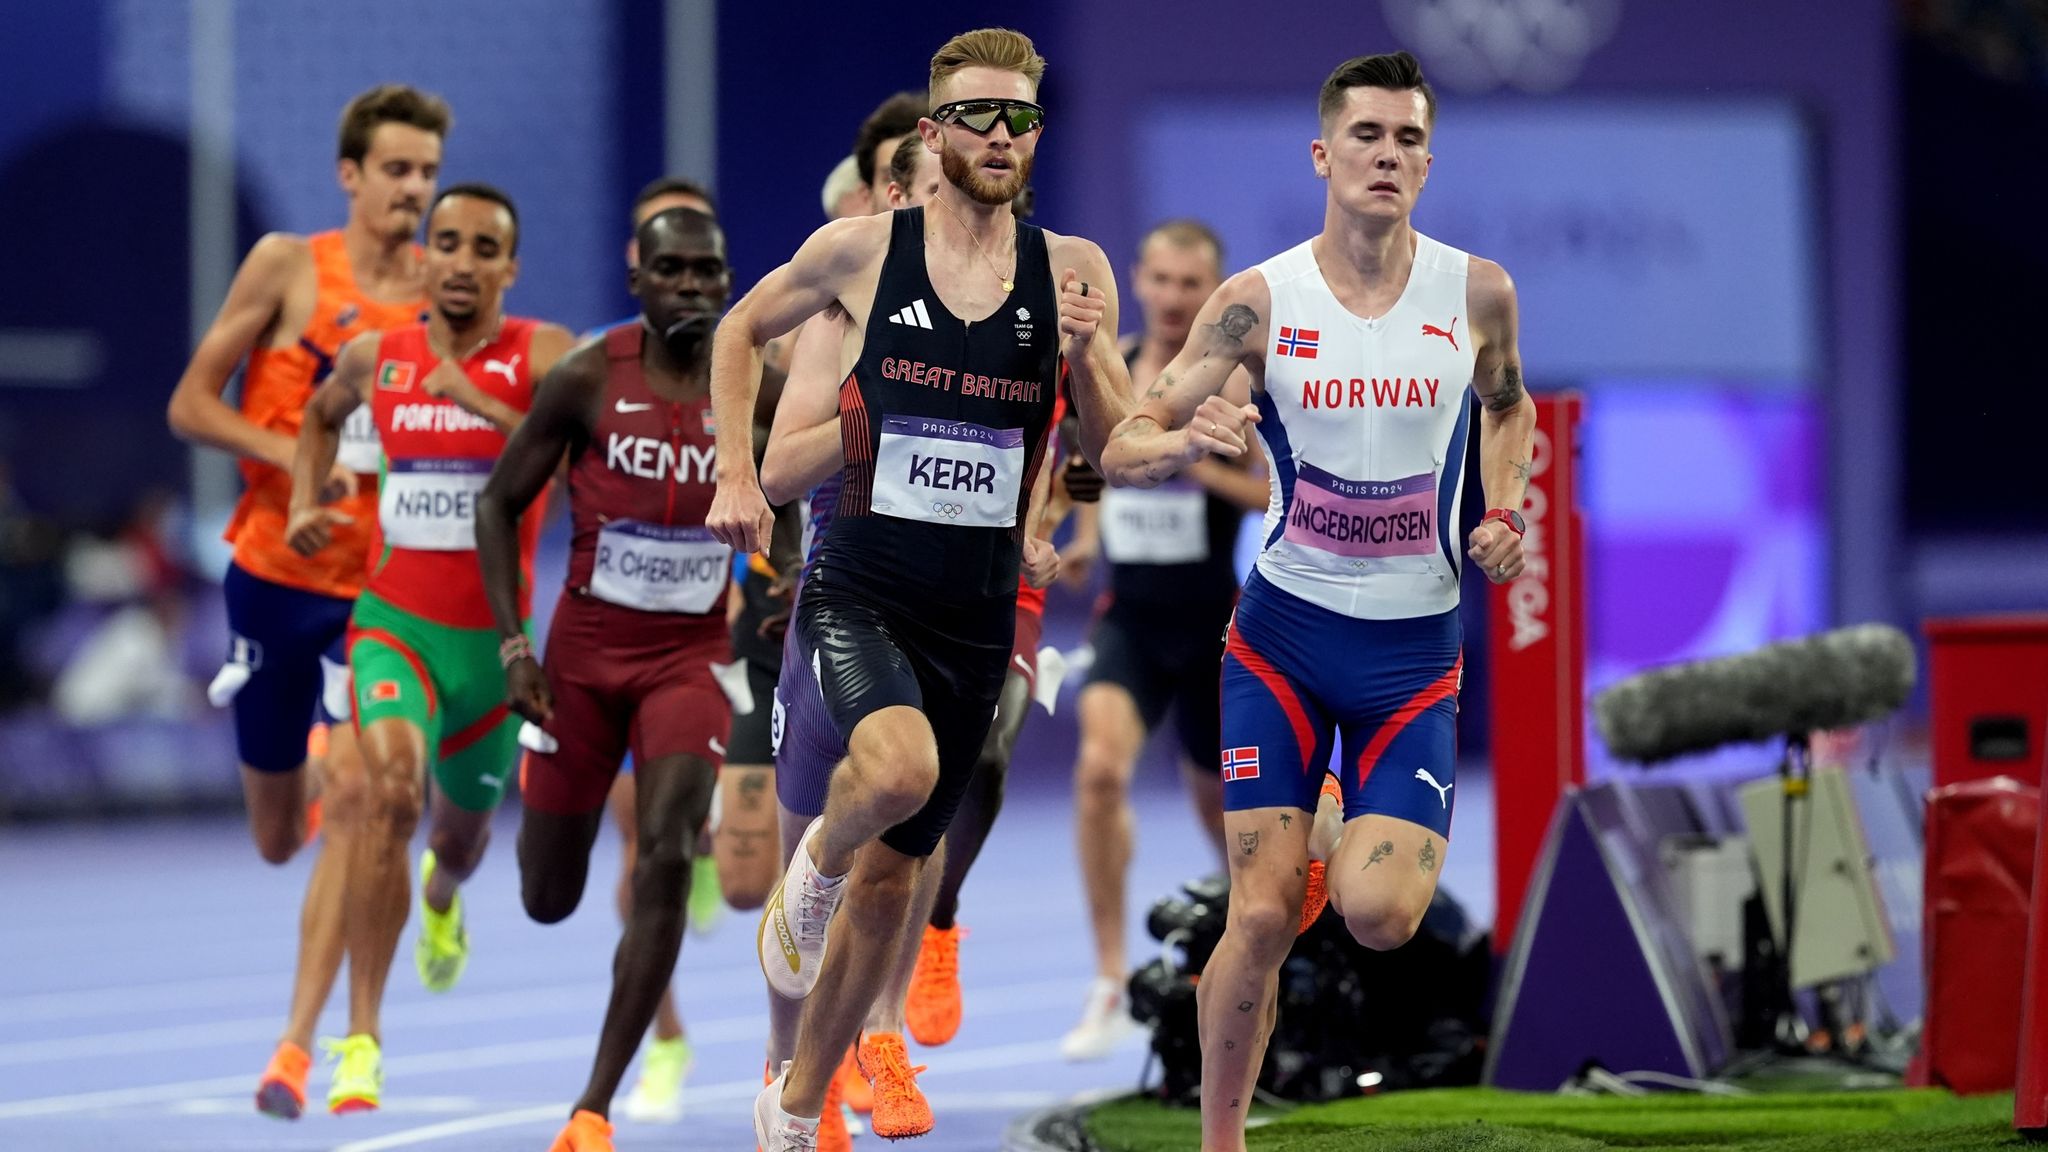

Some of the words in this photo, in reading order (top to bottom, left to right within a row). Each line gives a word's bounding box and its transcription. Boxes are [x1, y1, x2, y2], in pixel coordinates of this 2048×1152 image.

[881, 357, 956, 391] GREAT
[961, 373, 1042, 403] BRITAIN
[1302, 378, 1439, 409] NORWAY
[922, 423, 958, 435] PARIS
[962, 427, 994, 441] 2024
[607, 432, 717, 484] KENY
[908, 454, 996, 494] KERR
[1332, 479, 1367, 495] PARIS
[1371, 484, 1403, 496] 2024
[1292, 498, 1430, 544] INGEBRIGTSEN
[775, 908, 795, 955] BROOKS
